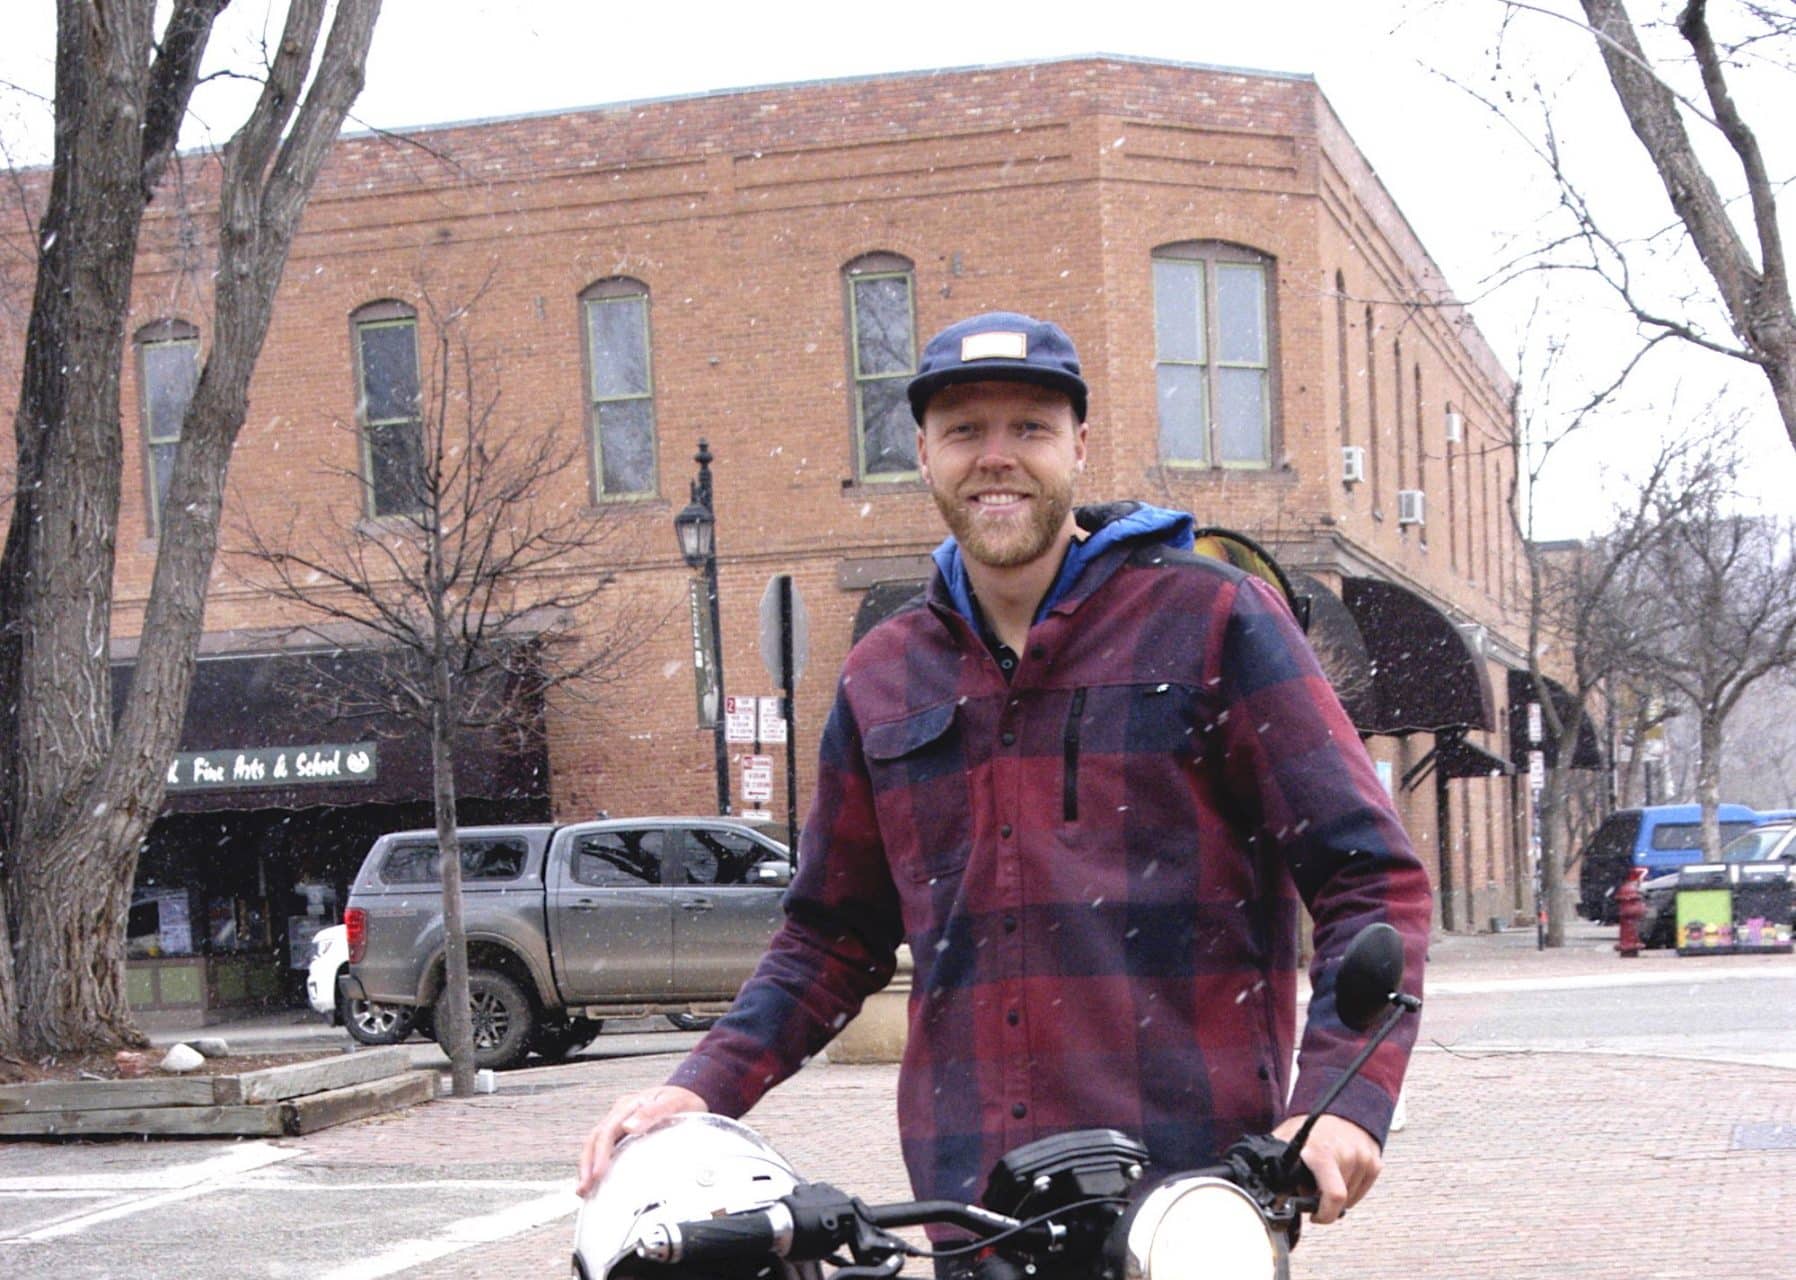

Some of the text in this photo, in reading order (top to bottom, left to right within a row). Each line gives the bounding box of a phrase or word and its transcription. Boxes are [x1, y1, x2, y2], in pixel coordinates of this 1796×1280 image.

[193, 756, 225, 783] Fine
[233, 754, 265, 780] Arts
[296, 749, 341, 777] School
